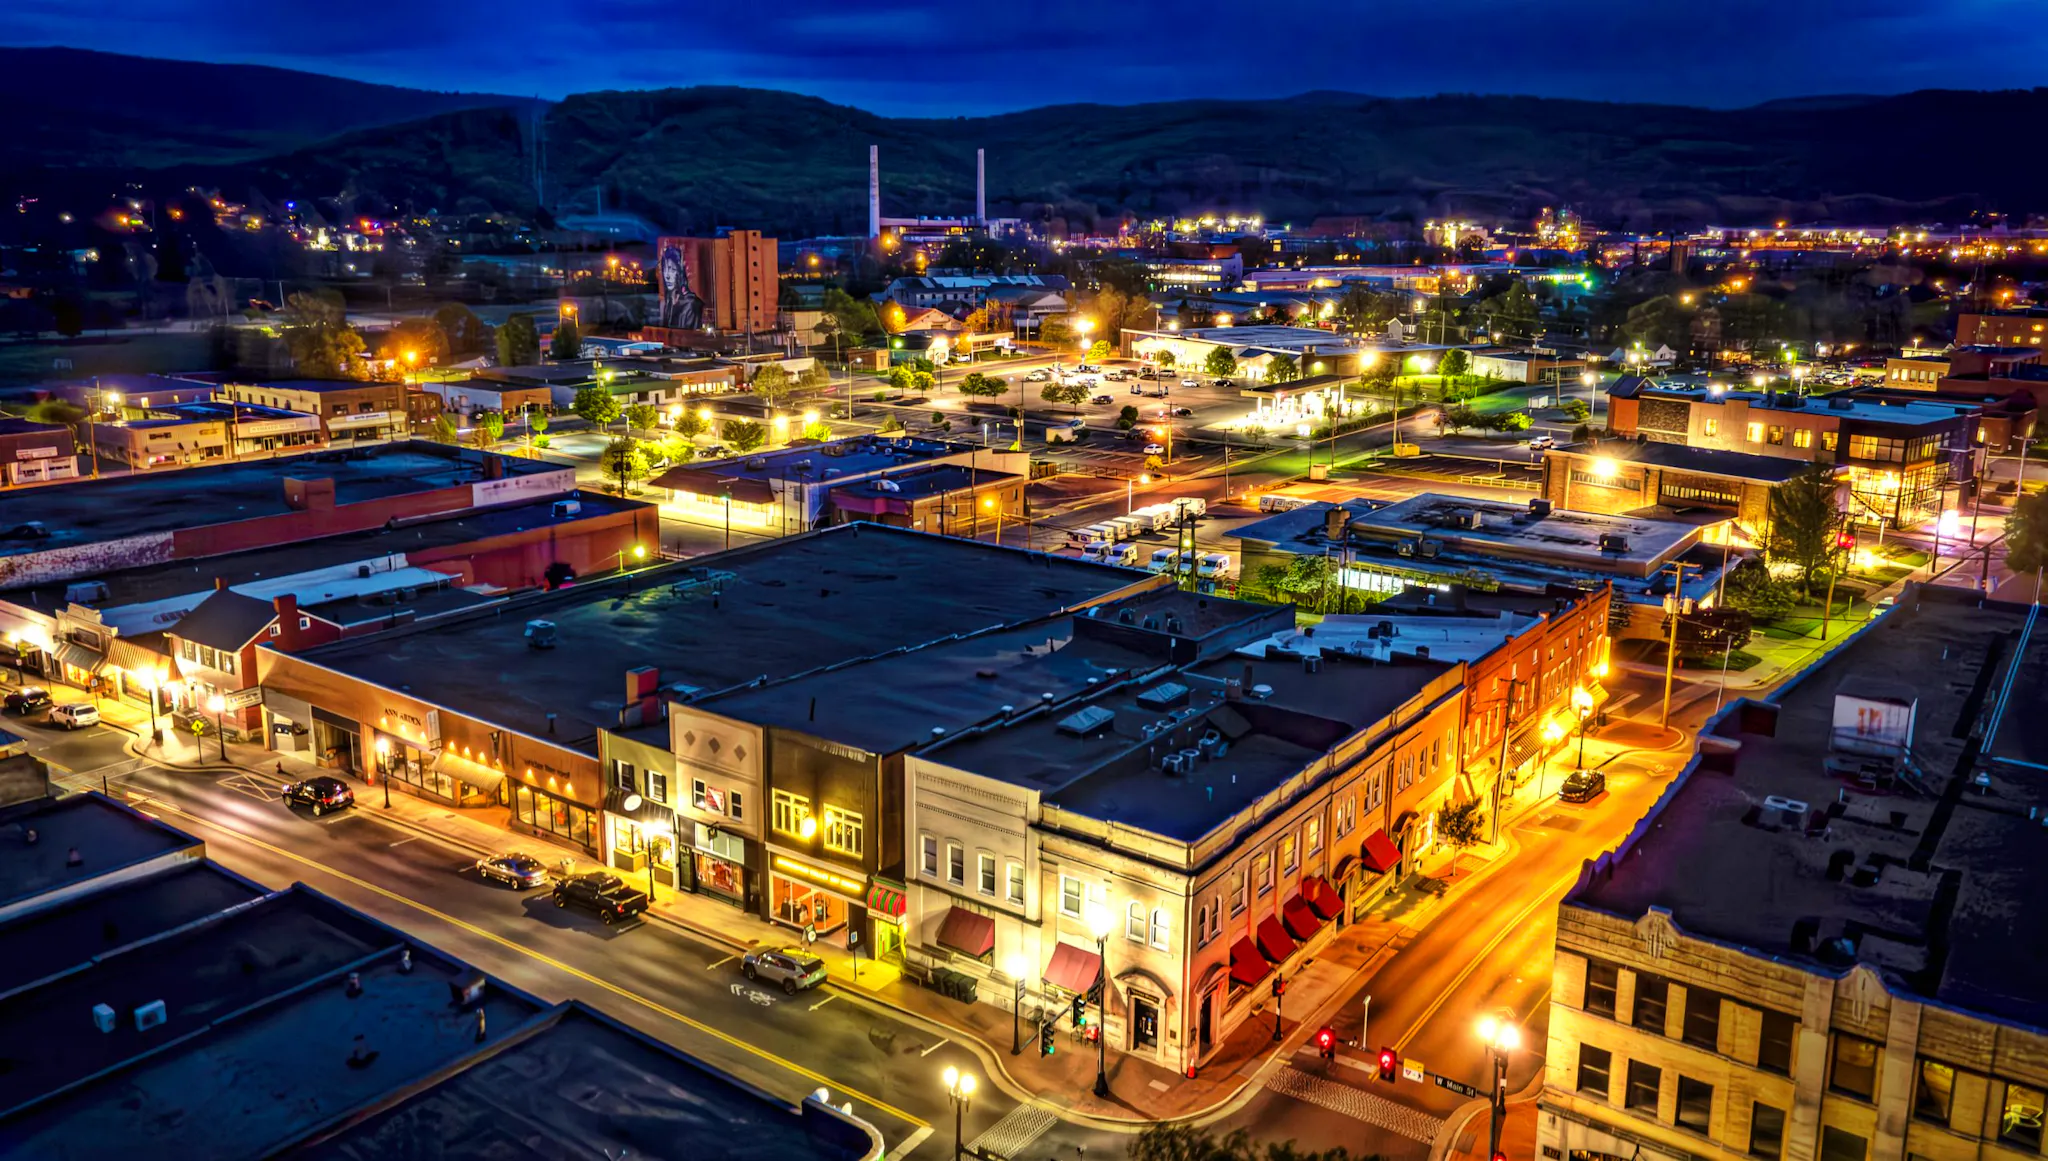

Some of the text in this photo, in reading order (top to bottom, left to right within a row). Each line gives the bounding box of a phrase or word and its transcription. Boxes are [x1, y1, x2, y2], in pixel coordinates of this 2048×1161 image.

[384, 708, 398, 718] ANN
[1436, 1077, 1475, 1097] W Main St
